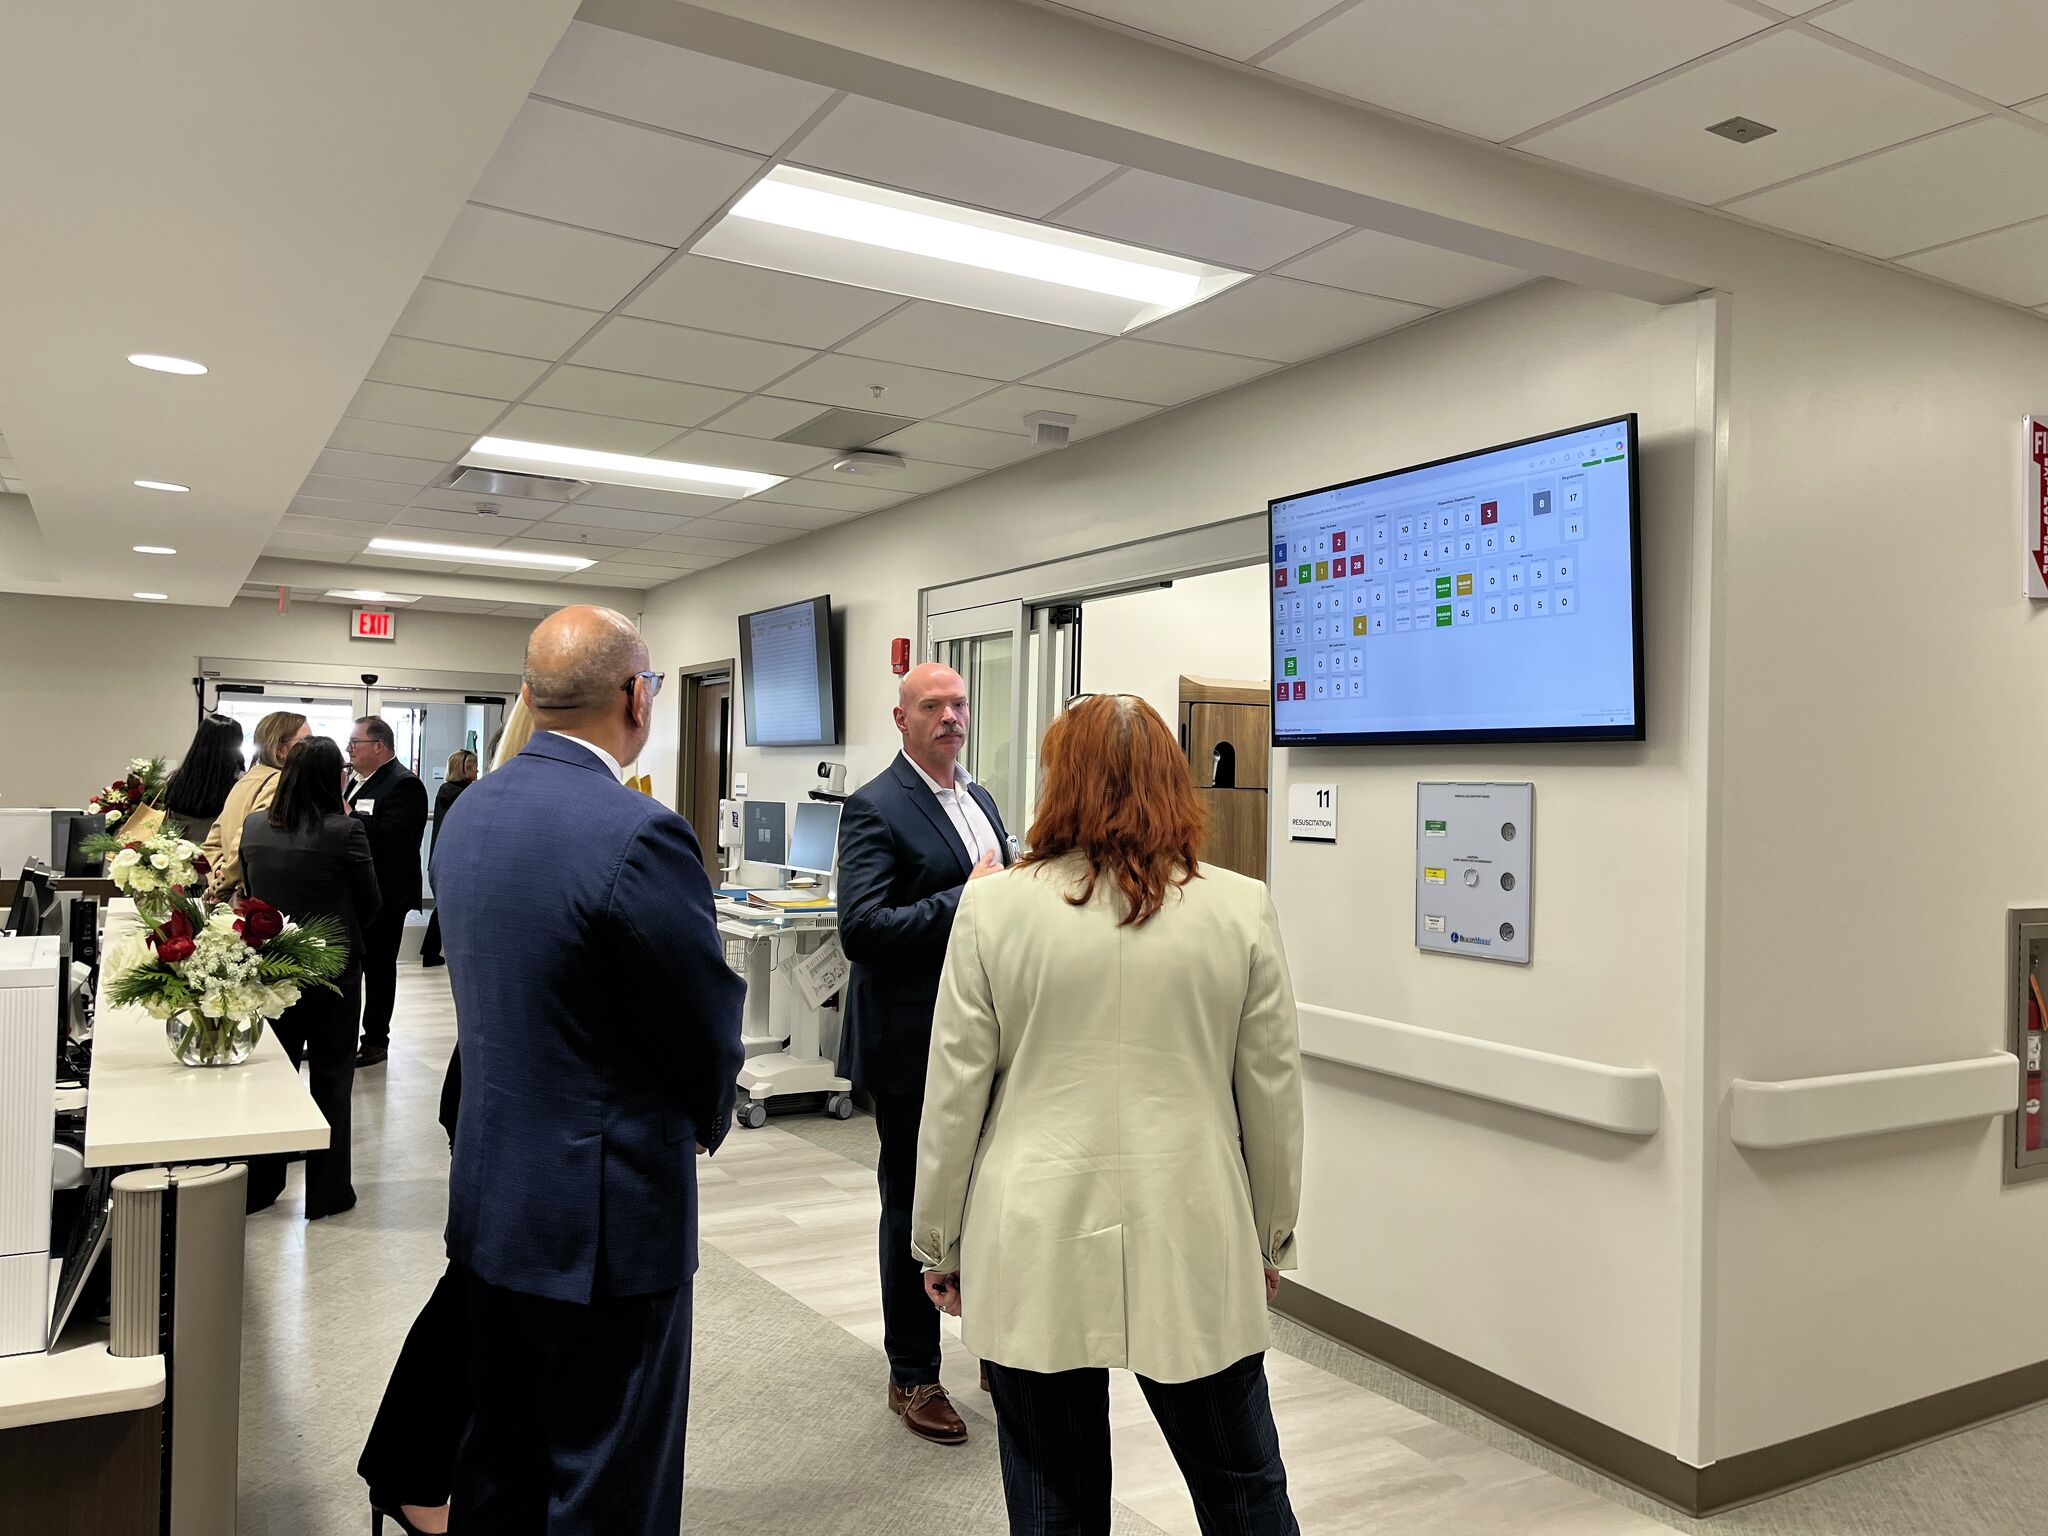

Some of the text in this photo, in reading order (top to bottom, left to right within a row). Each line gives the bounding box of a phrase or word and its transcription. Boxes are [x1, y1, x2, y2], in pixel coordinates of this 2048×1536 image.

[1570, 493, 1577, 502] 17
[1487, 509, 1492, 518] 3
[1401, 525, 1409, 533] 10
[1510, 535, 1515, 543] 0
[1465, 542, 1470, 551] 0
[1537, 570, 1542, 579] 5
[1561, 567, 1567, 576] 0
[1538, 601, 1543, 609] 5
[1562, 598, 1568, 606] 0
[1490, 606, 1496, 614] 0
[1513, 604, 1519, 612] 0
[1460, 609, 1470, 618] 45
[359, 613, 389, 636] EXIT
[1316, 789, 1330, 808] 11
[1292, 818, 1331, 827] RESUSCITATION
